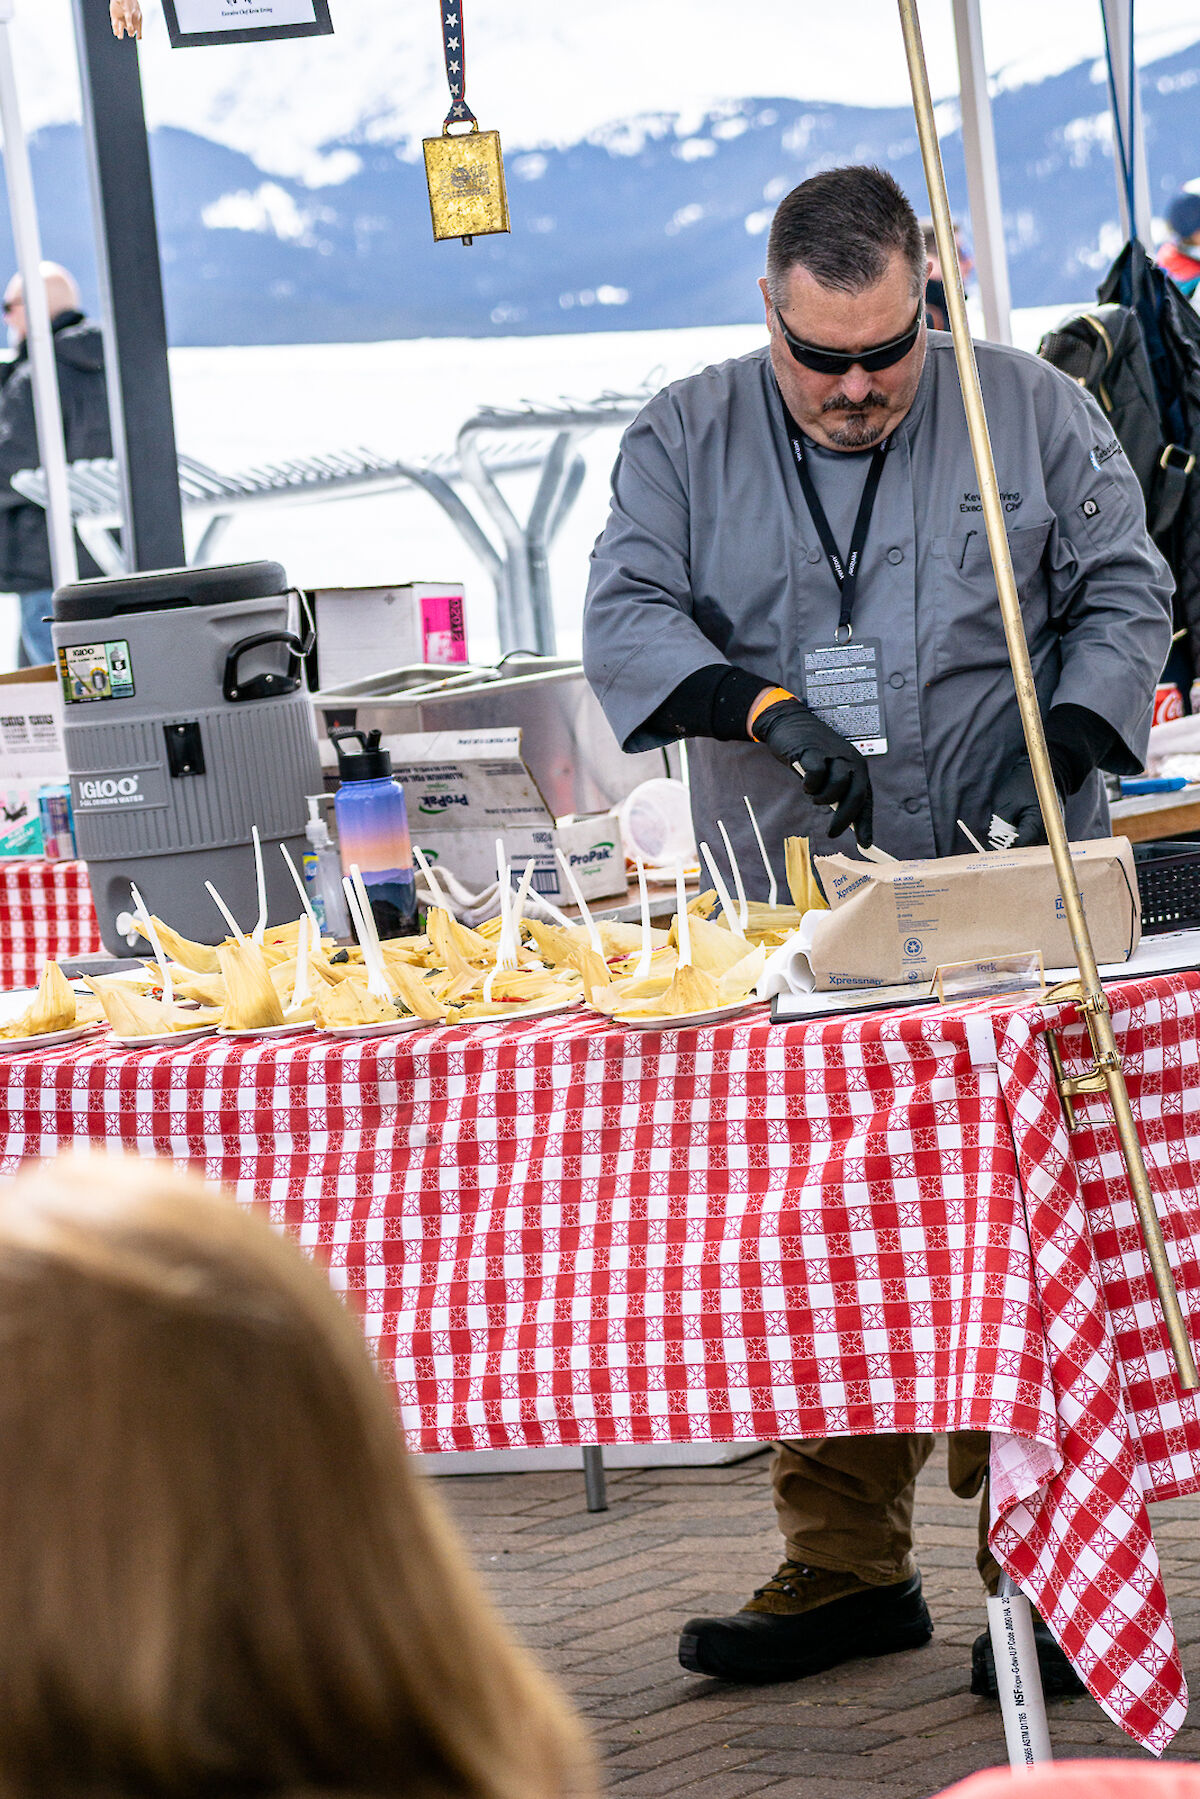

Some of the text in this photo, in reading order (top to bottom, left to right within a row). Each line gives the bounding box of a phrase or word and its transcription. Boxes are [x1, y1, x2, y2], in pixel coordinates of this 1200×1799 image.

[963, 492, 982, 502] Kev
[423, 793, 470, 808] ProPak
[569, 848, 610, 866] ProPak
[832, 874, 849, 889] Tork
[975, 963, 998, 973] Tork
[1022, 1729, 1031, 1747] ASTM
